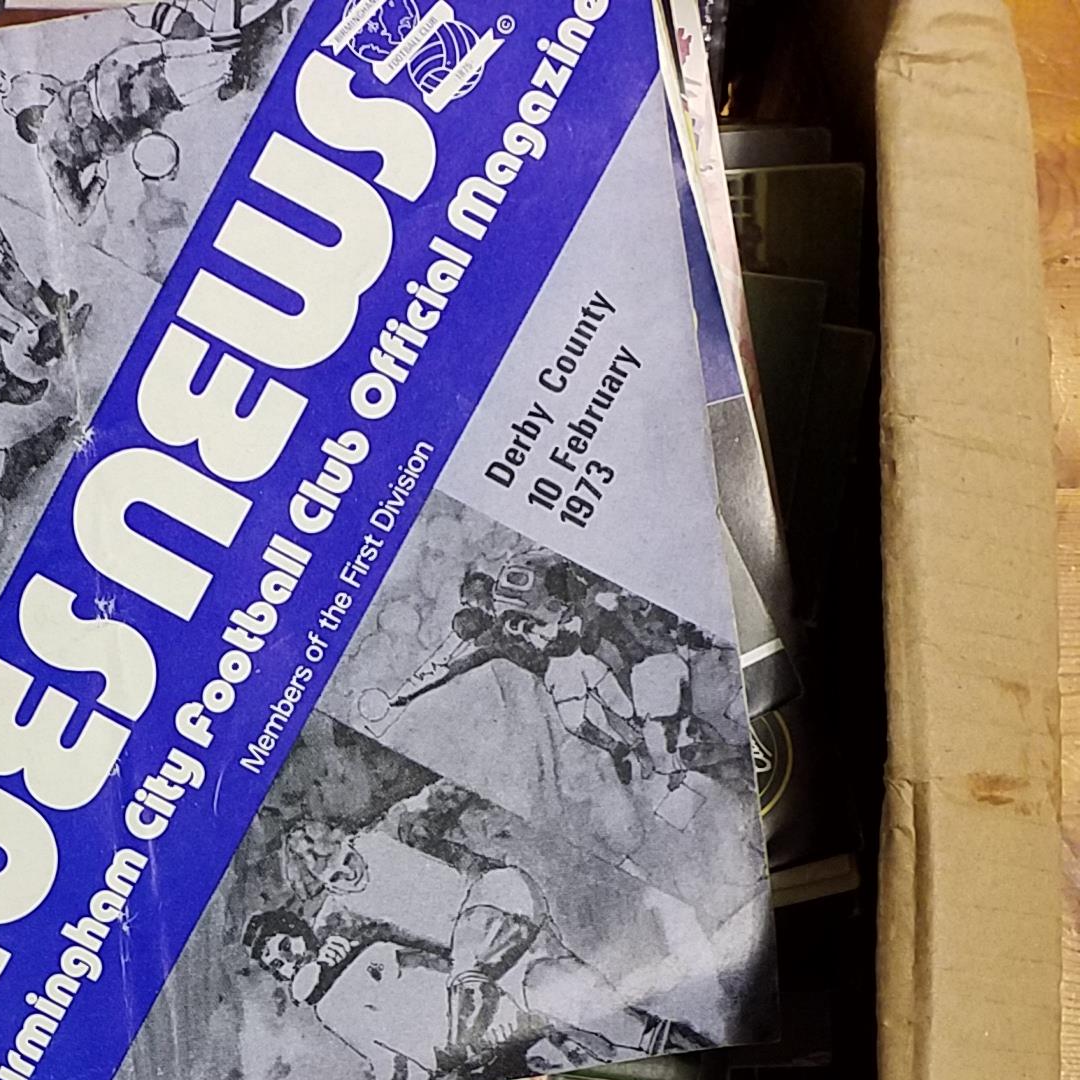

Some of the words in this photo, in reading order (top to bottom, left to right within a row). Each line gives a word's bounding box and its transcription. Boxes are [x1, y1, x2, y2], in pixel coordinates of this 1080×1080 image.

[387, 36, 421, 71] FOOTBALL
[420, 15, 438, 41] CLUB
[123, 747, 206, 841] City
[174, 532, 314, 749] Football
[288, 430, 370, 535] Club
[349, 235, 473, 420] Official
[446, 0, 610, 241] Magazine
[484, 402, 554, 488] Derby
[538, 290, 616, 393] County
[527, 477, 562, 510] 10
[549, 345, 641, 472] February
[560, 460, 614, 528] 1973
[239, 664, 313, 775] Members
[305, 630, 329, 662] of
[318, 592, 353, 631] the
[339, 533, 384, 589] First
[369, 441, 434, 533] Division
